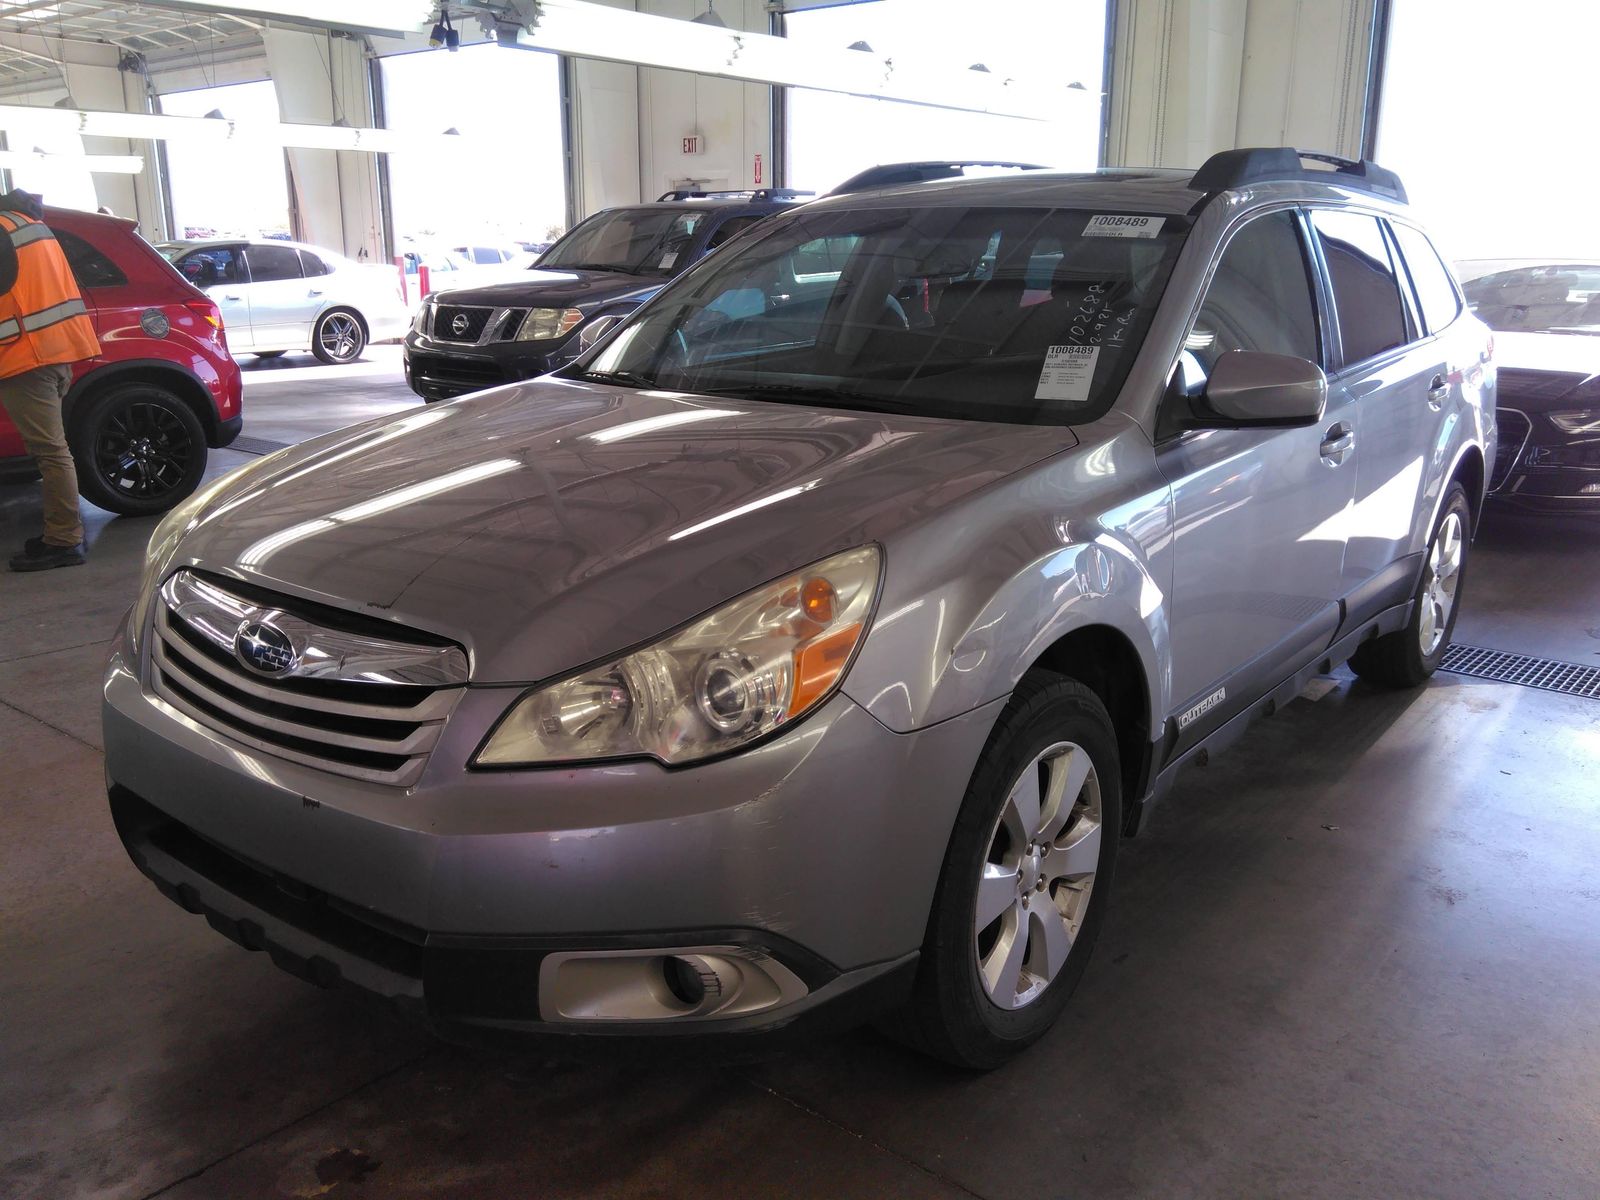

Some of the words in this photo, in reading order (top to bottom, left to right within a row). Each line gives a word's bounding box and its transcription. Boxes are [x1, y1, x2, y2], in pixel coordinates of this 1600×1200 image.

[683, 137, 697, 153] EXIT
[1094, 216, 1149, 227] 1008489
[1049, 346, 1094, 354] 1008489
[1179, 687, 1226, 729] OUTBACK
